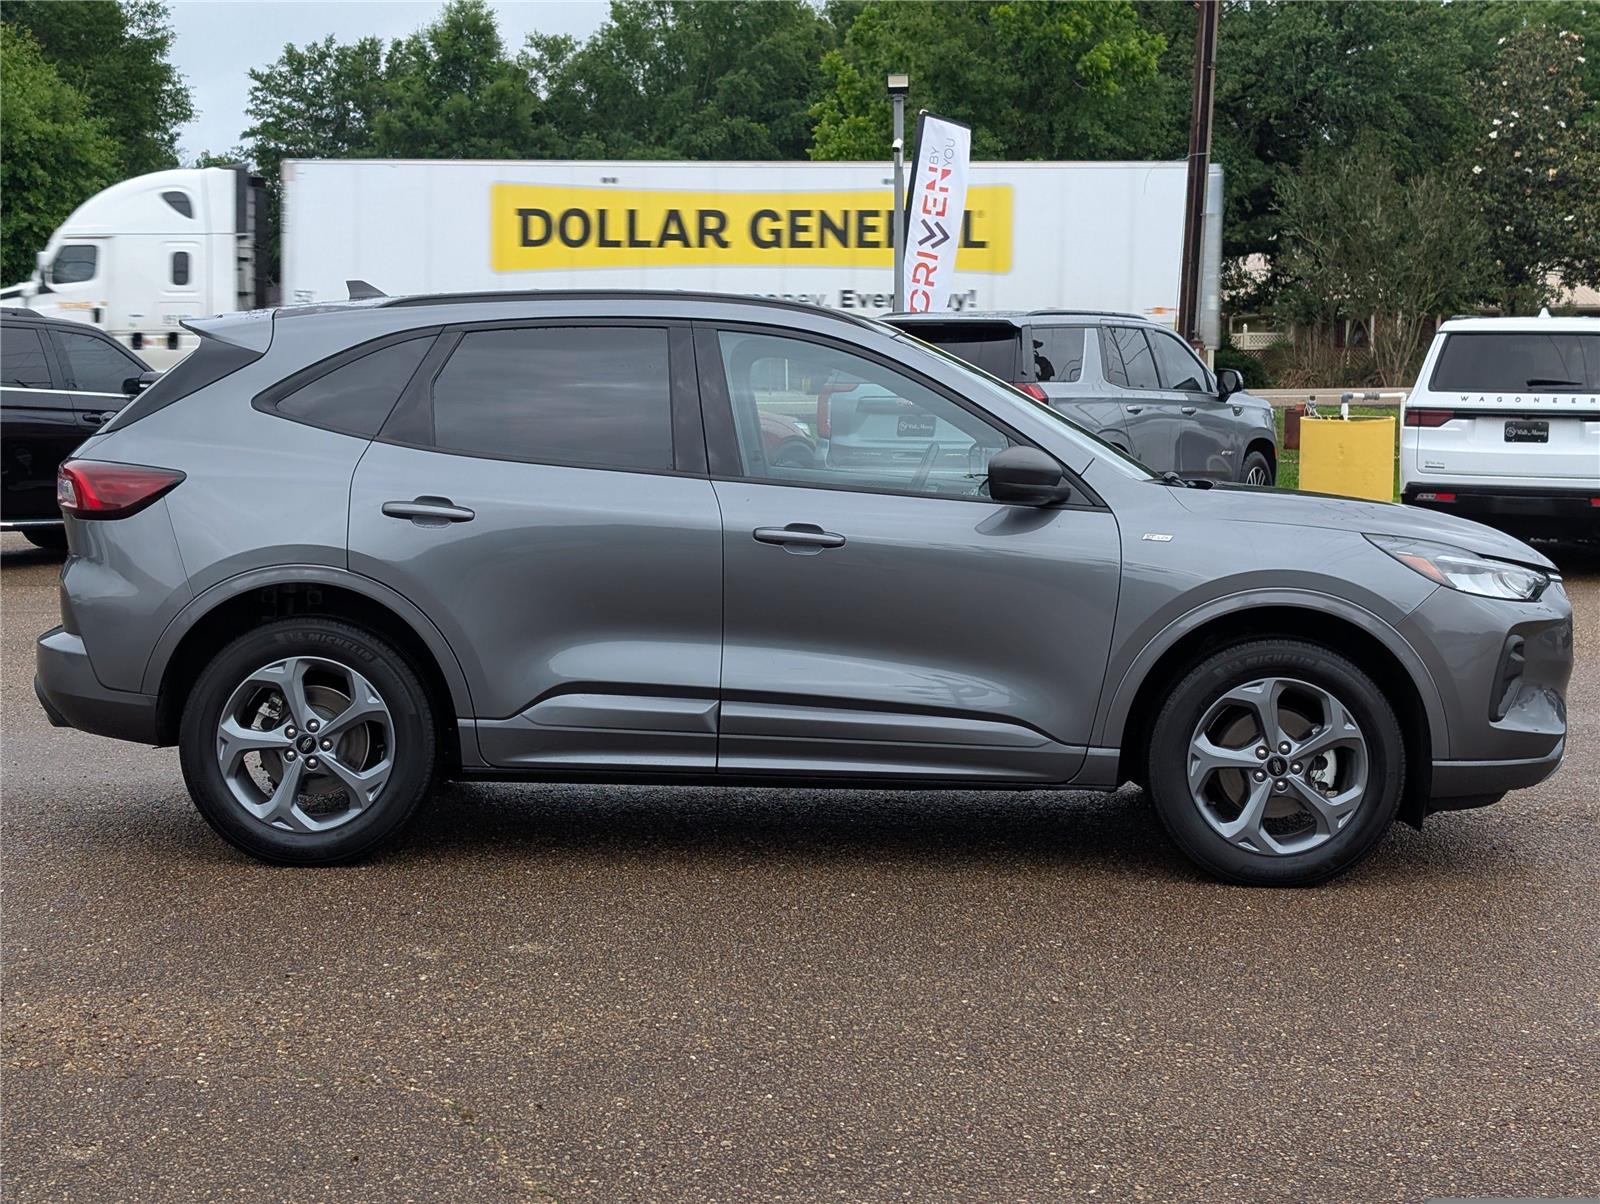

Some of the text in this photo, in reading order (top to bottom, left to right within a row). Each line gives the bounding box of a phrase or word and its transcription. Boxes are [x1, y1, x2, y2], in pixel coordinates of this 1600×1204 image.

[928, 148, 940, 165] BY
[943, 137, 957, 168] YOU
[517, 208, 989, 249] DOLLAR GENEL
[839, 289, 897, 308] Ever
[1460, 395, 1596, 404] WAGONEER
[308, 632, 375, 661] MICHELIN
